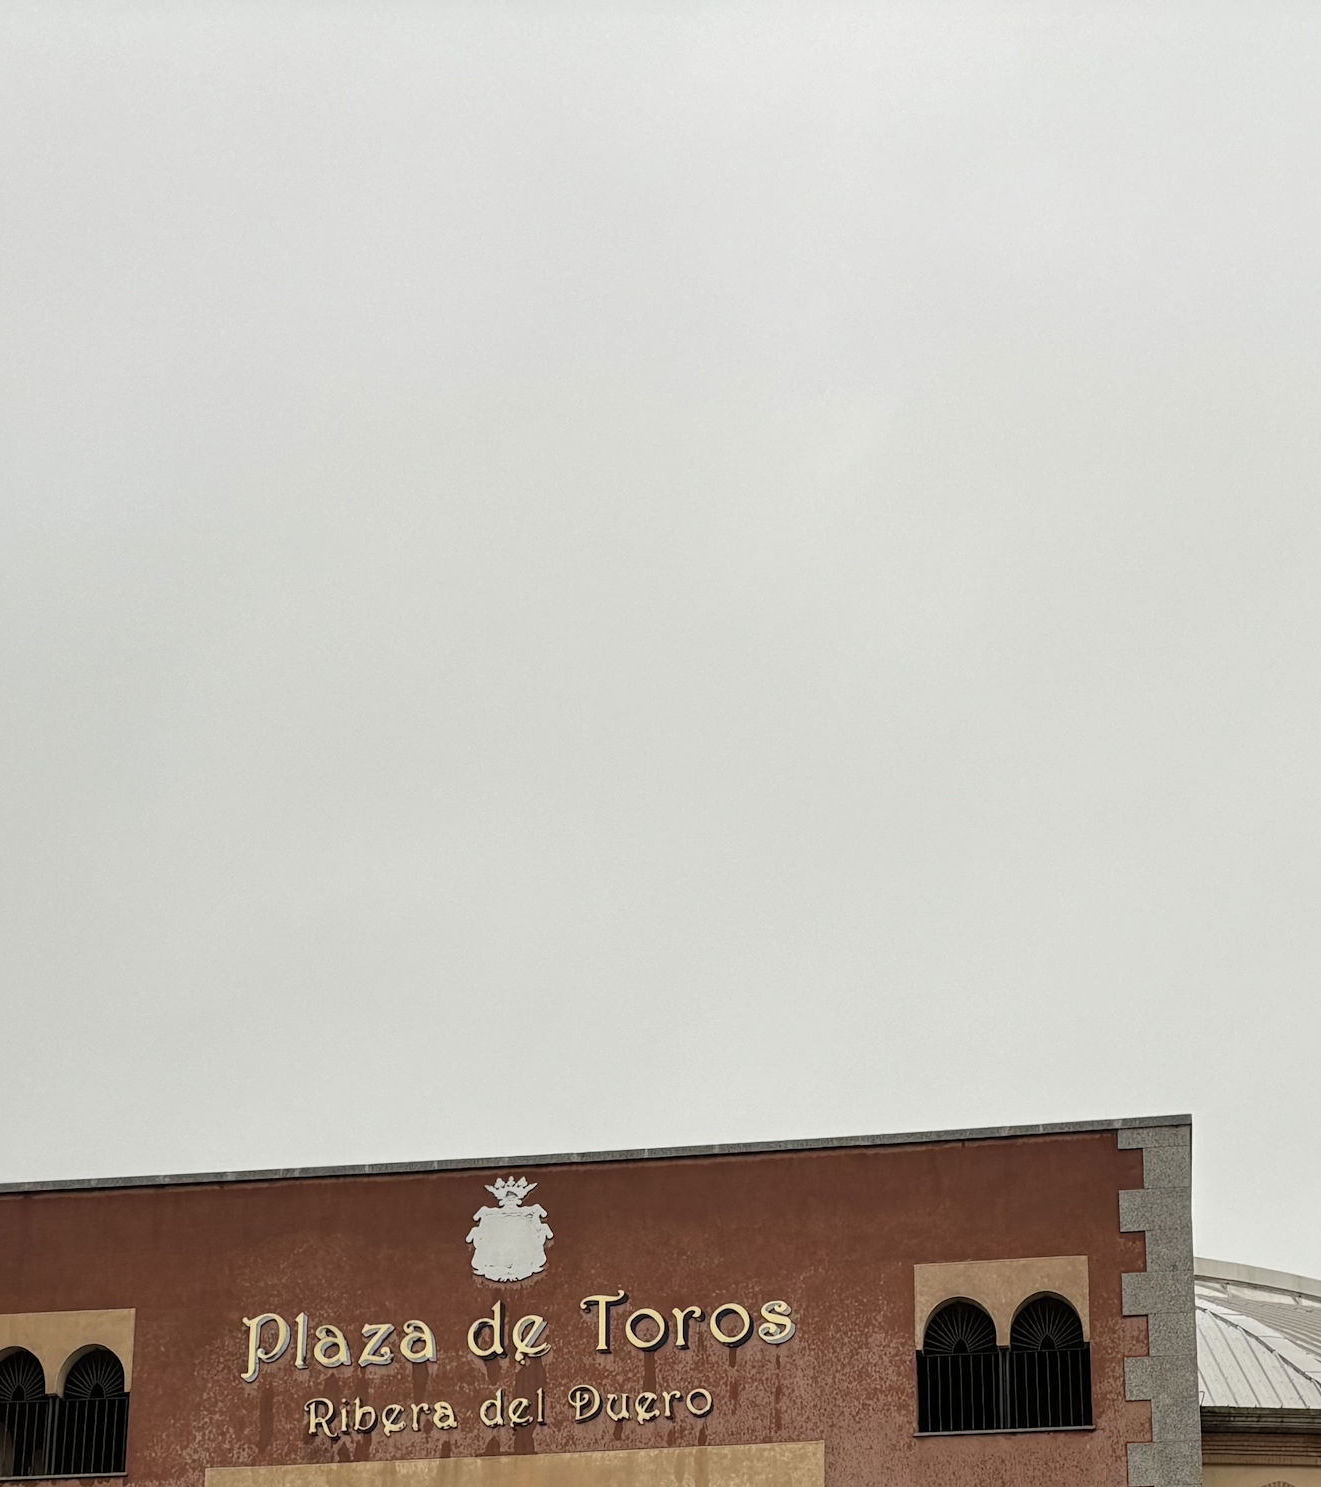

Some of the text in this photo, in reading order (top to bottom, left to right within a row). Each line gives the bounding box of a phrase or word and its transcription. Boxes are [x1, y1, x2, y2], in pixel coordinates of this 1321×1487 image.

[240, 1289, 796, 1382] Plaza de Toros
[303, 1384, 714, 1438] Ribera del Duero
